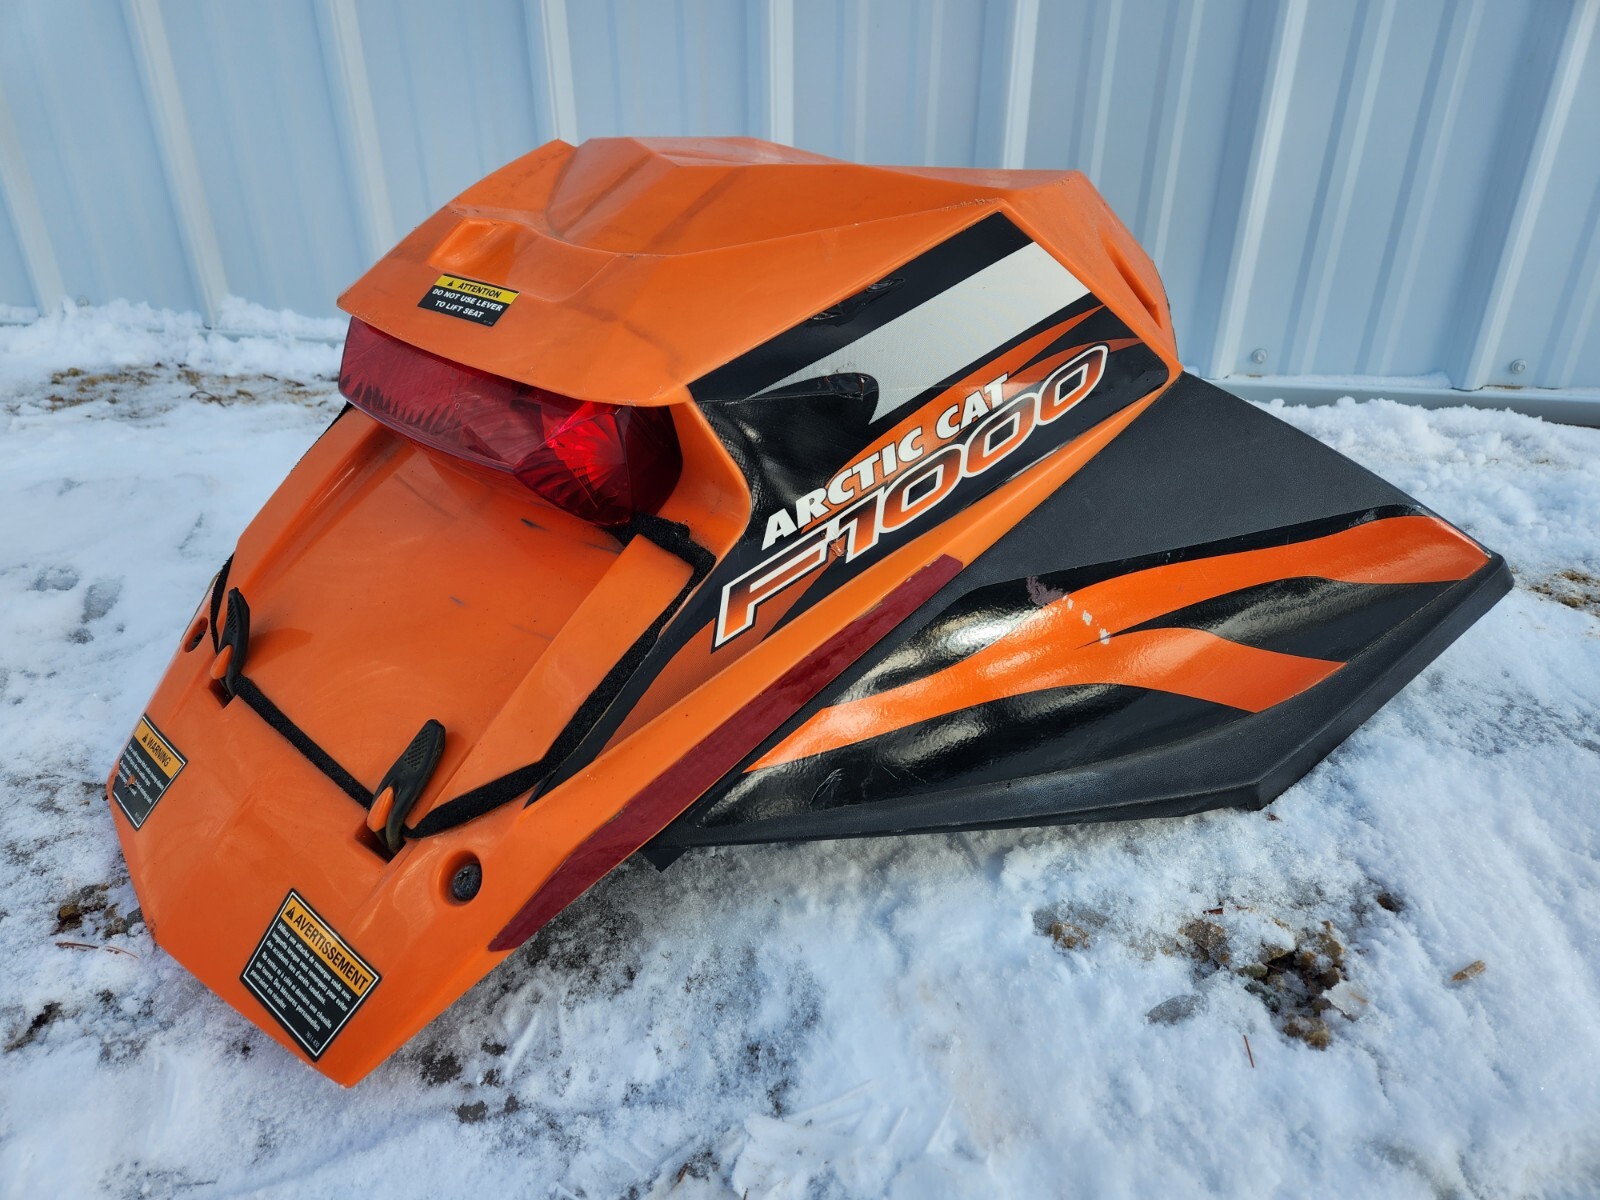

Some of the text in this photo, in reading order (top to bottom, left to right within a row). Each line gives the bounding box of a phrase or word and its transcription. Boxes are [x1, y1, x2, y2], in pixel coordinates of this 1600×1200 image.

[432, 288, 503, 311] DO NOT USE LEVER
[458, 283, 502, 298] ATTENTION
[446, 303, 463, 312] LIFT
[463, 308, 484, 318] SEAT
[762, 374, 1009, 550] ARCTIC CAT
[714, 345, 1109, 649] F1000
[147, 737, 172, 767] WARNING
[293, 912, 368, 990] AVERTISSEMENT
[308, 954, 315, 963] de
[341, 989, 351, 1001] avec
[309, 1003, 317, 1012] une
[325, 989, 336, 1001] pour
